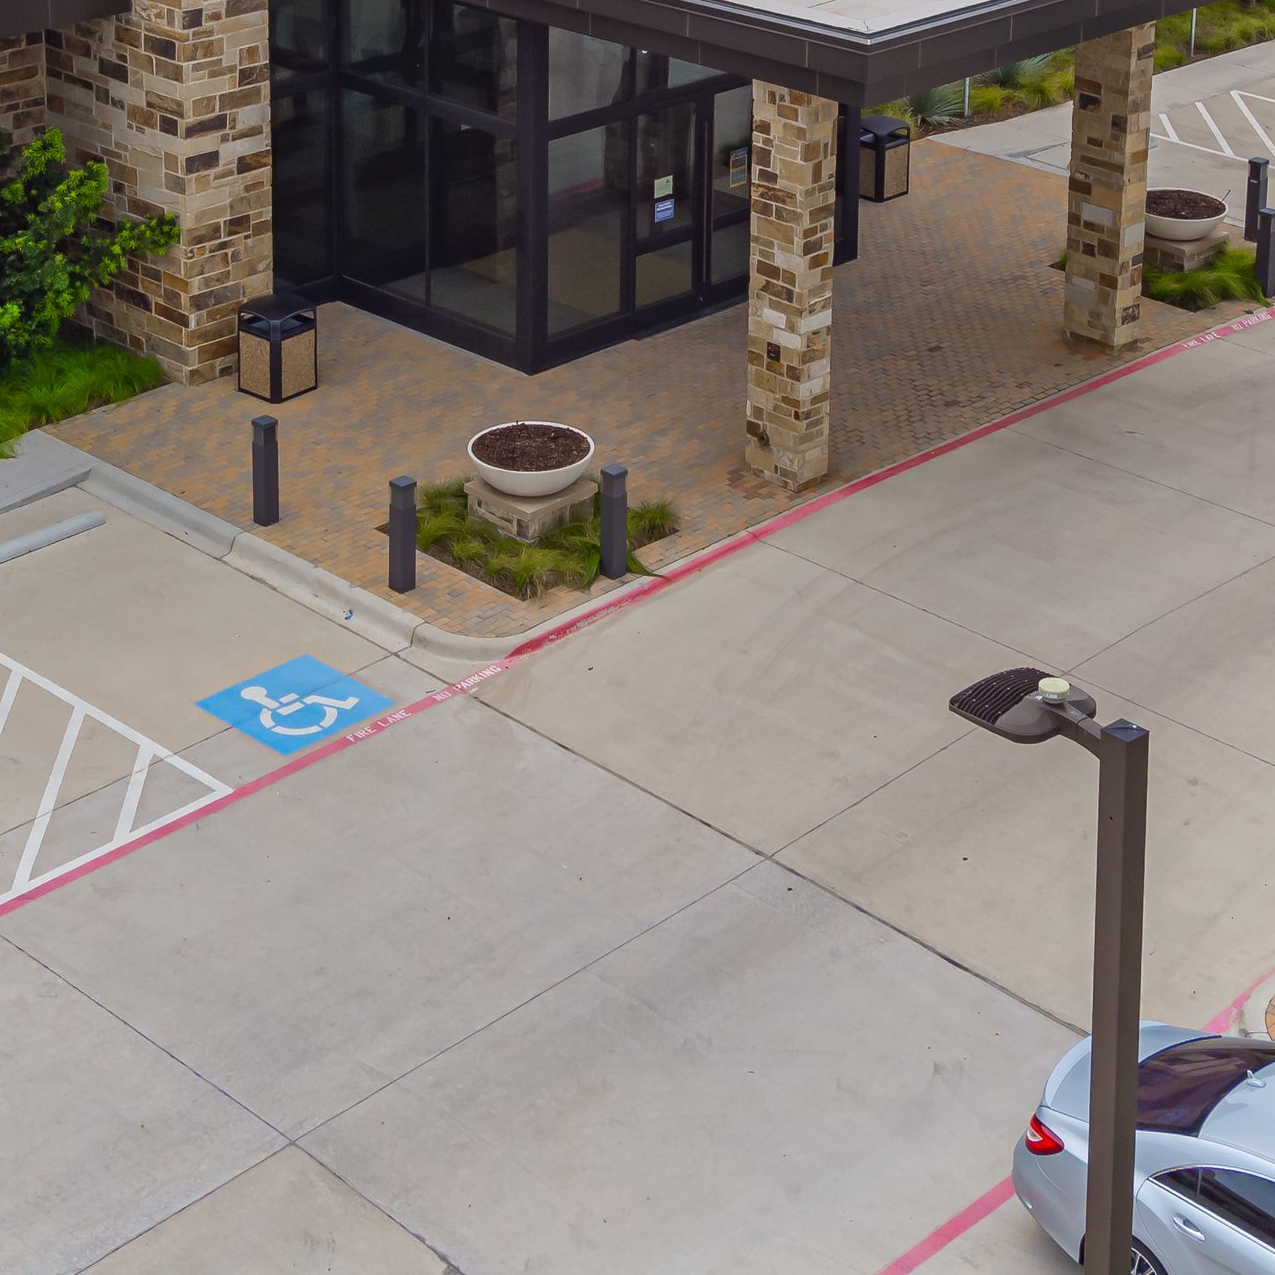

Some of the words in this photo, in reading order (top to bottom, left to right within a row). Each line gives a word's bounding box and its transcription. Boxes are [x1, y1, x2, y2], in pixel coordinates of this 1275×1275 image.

[346, 726, 377, 742] FIRE
[377, 709, 412, 727] LANE
[432, 691, 452, 702] NO
[453, 665, 502, 692] PARKING
